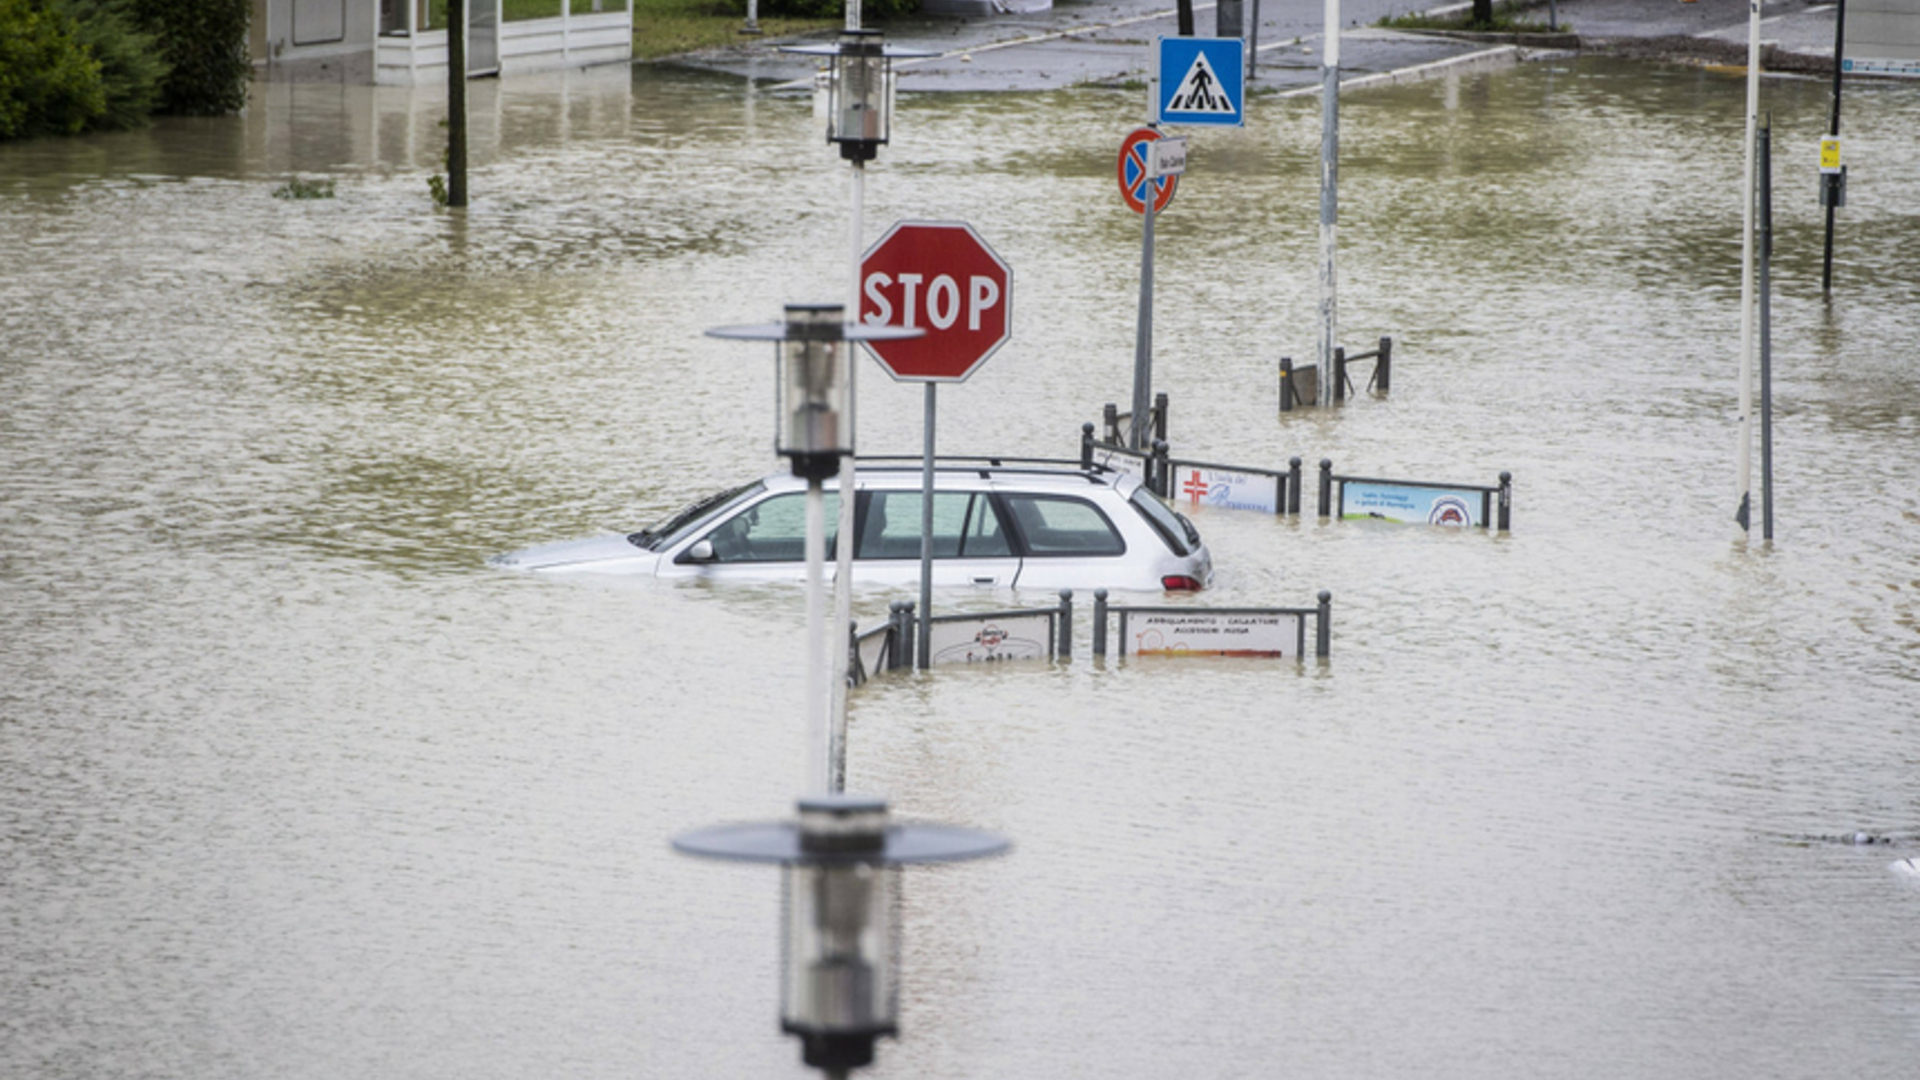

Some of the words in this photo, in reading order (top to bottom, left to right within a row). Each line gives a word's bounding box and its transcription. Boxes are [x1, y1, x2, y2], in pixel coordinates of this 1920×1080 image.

[864, 272, 1000, 331] STOP
[1146, 617, 1218, 625] ABBIGLIAMENTO
[1227, 617, 1280, 625] CALZATURE
